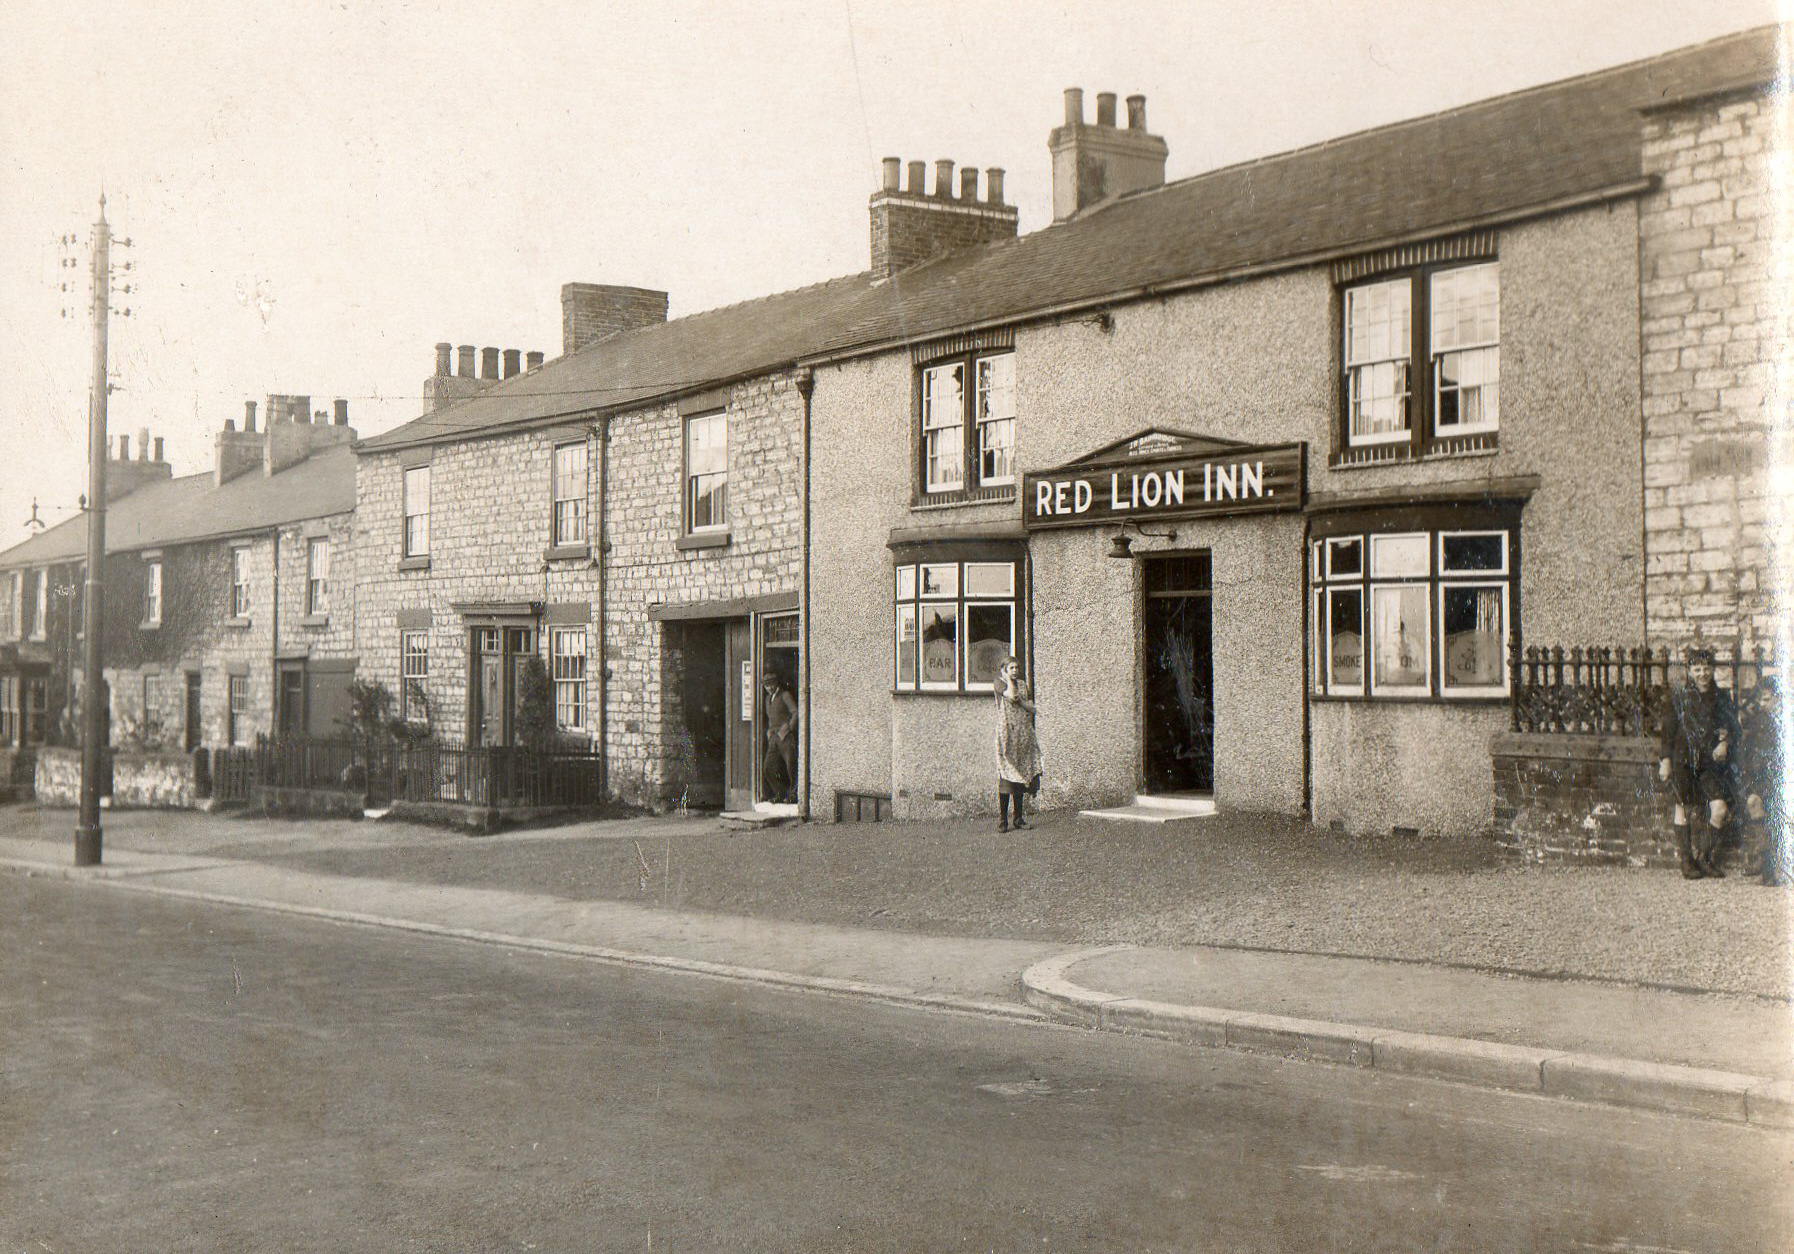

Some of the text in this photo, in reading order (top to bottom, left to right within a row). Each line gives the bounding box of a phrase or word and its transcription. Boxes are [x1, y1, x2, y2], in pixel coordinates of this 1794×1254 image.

[1036, 461, 1274, 516] RED LION INN.
[929, 657, 951, 669] BAR
[1333, 654, 1361, 669] SMOKE
